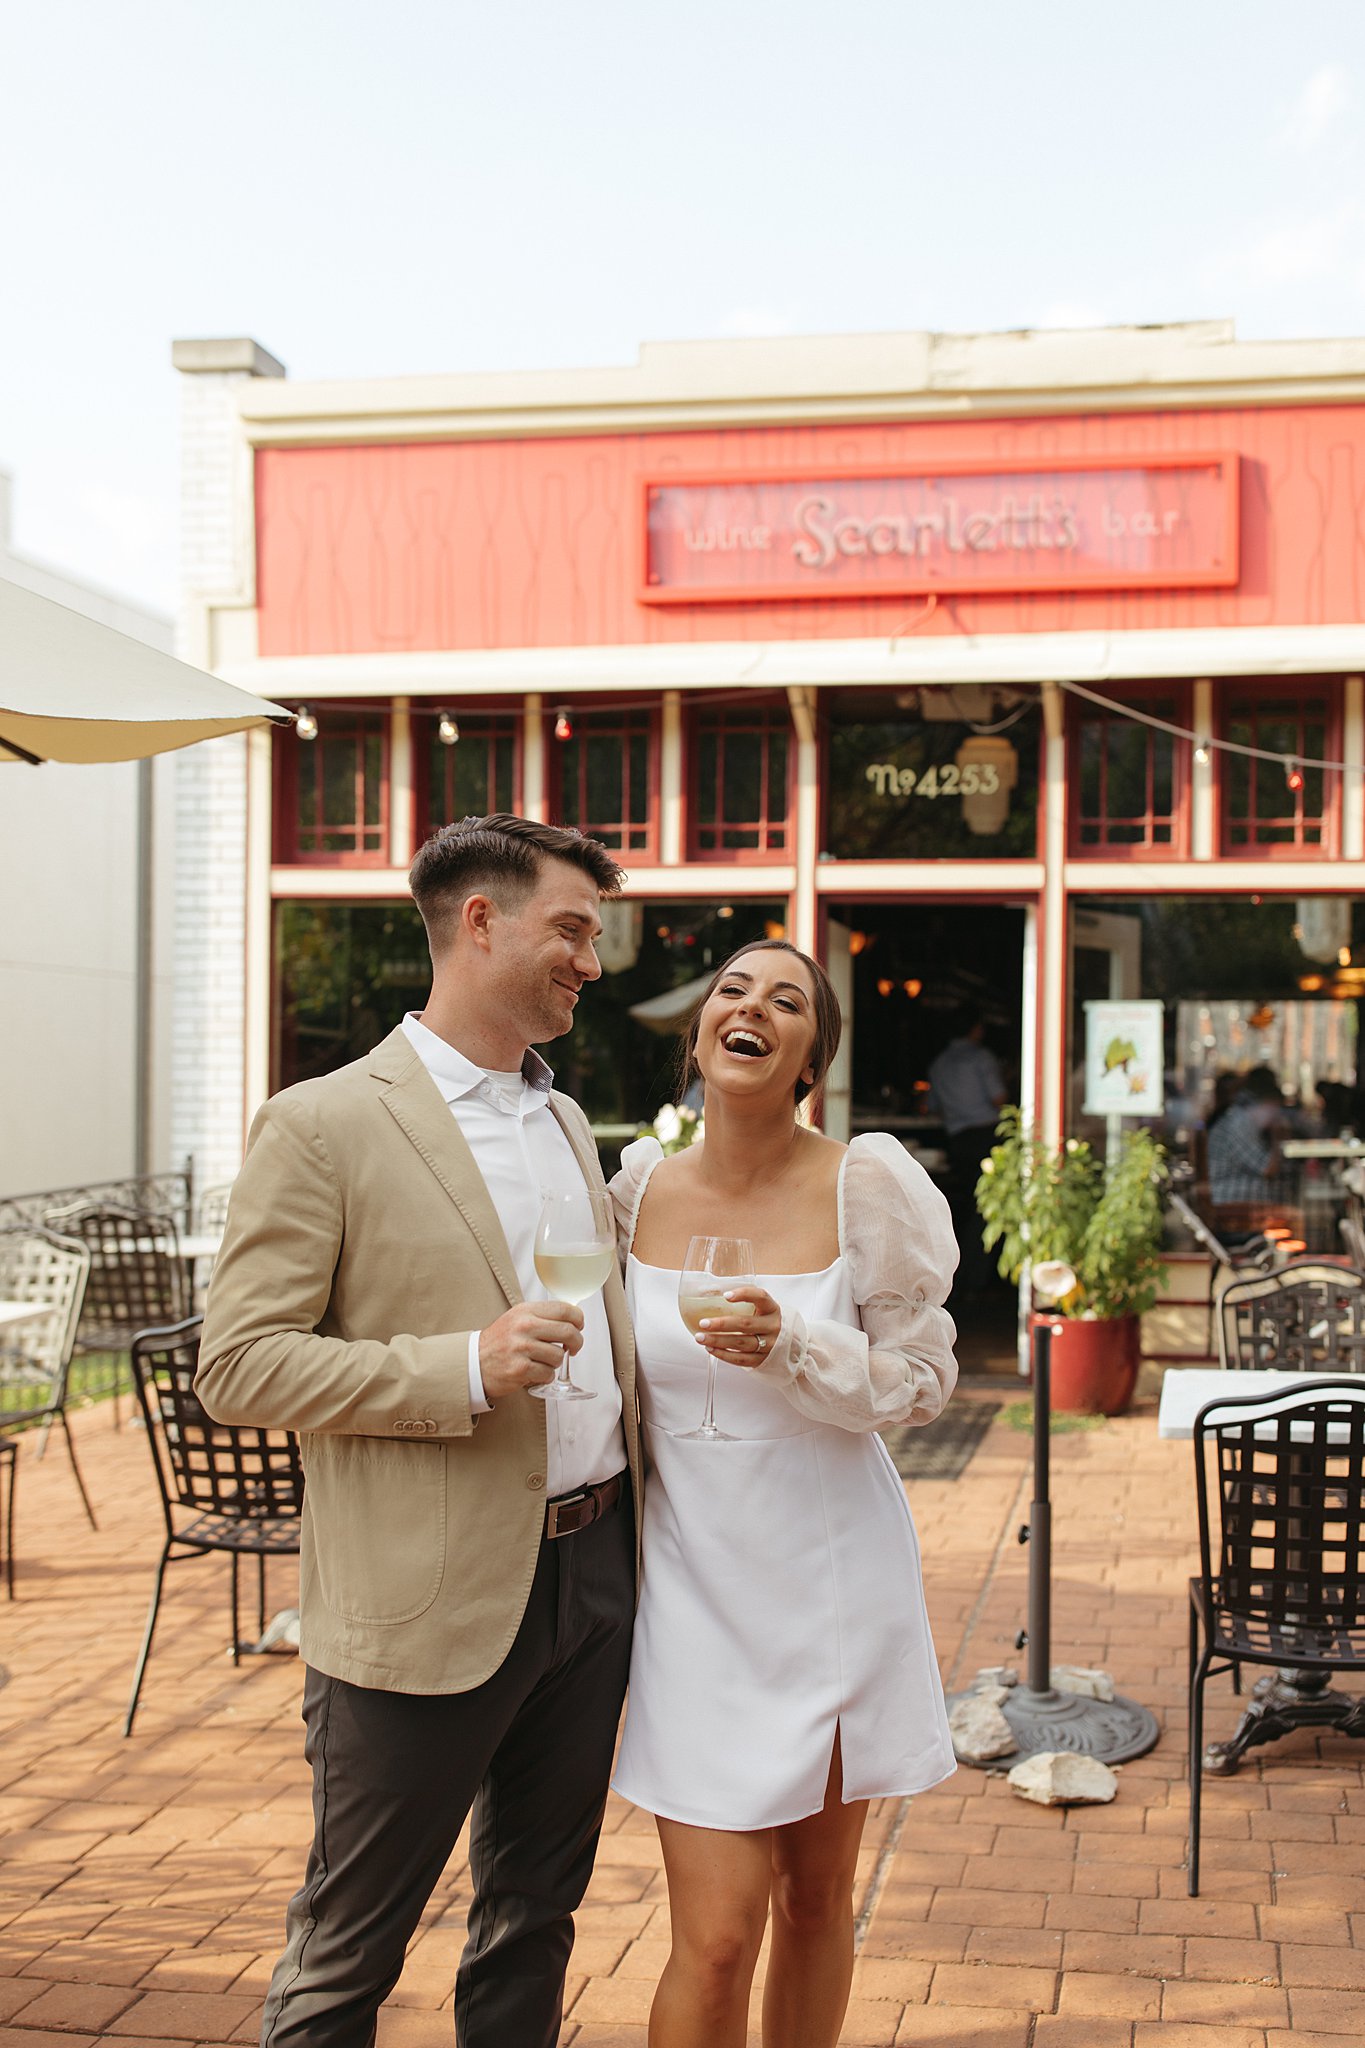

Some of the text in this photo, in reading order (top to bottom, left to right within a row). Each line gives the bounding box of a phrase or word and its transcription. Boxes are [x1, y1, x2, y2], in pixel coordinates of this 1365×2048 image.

[684, 497, 1180, 567] wine Scarlett's bar
